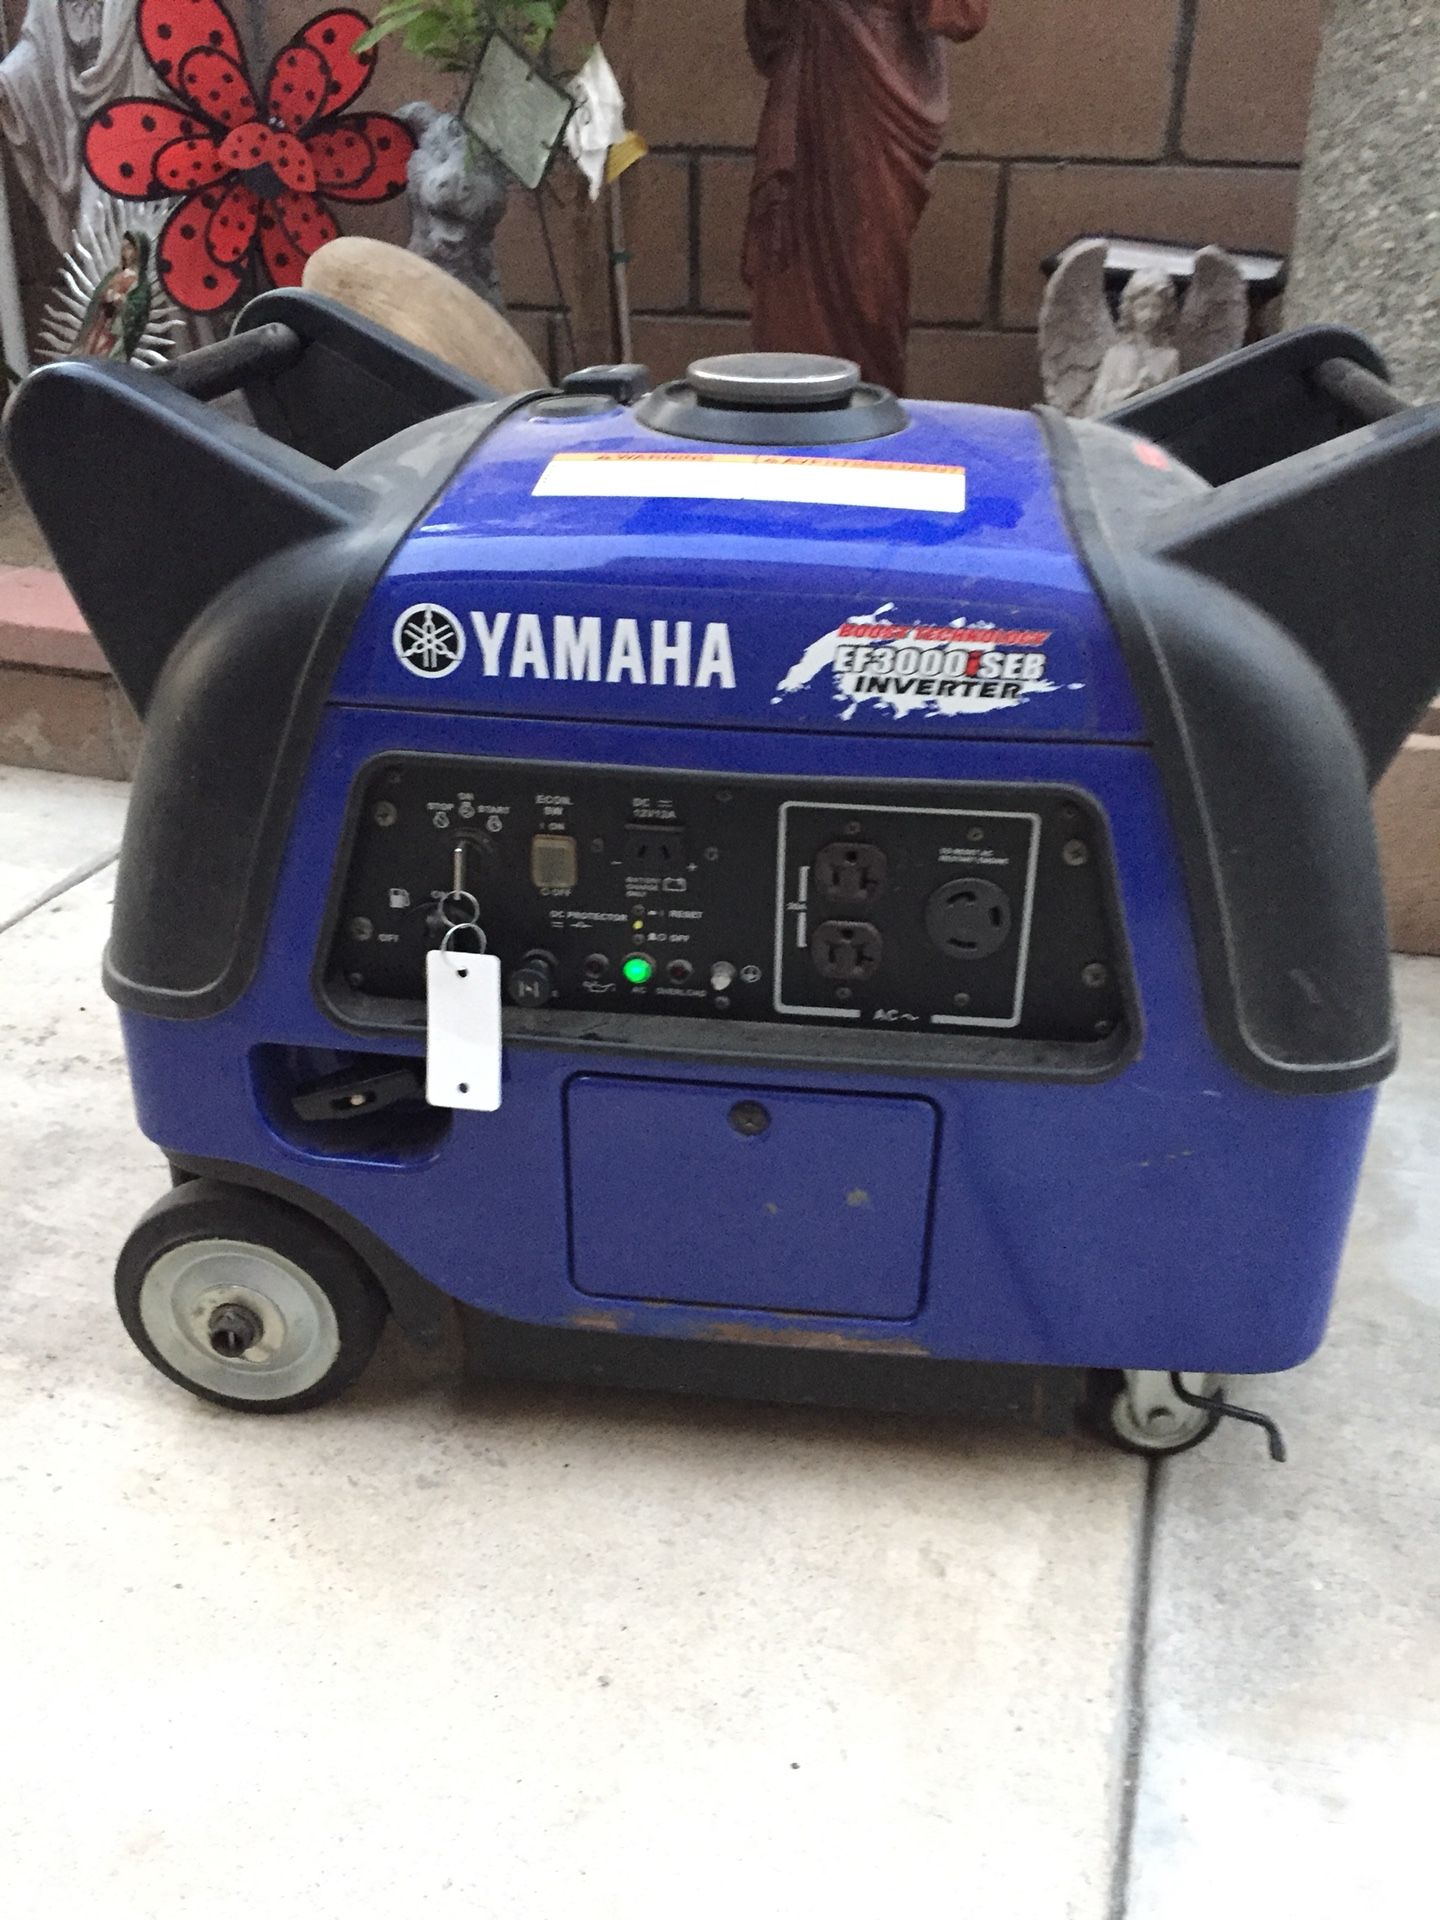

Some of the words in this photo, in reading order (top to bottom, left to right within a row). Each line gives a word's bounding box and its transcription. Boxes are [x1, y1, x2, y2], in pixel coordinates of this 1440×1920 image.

[470, 611, 737, 689] YAMAHA
[834, 644, 1047, 681] EF3000iSEB
[854, 675, 1022, 699] INVERTER
[566, 911, 628, 921] PROTECTOR
